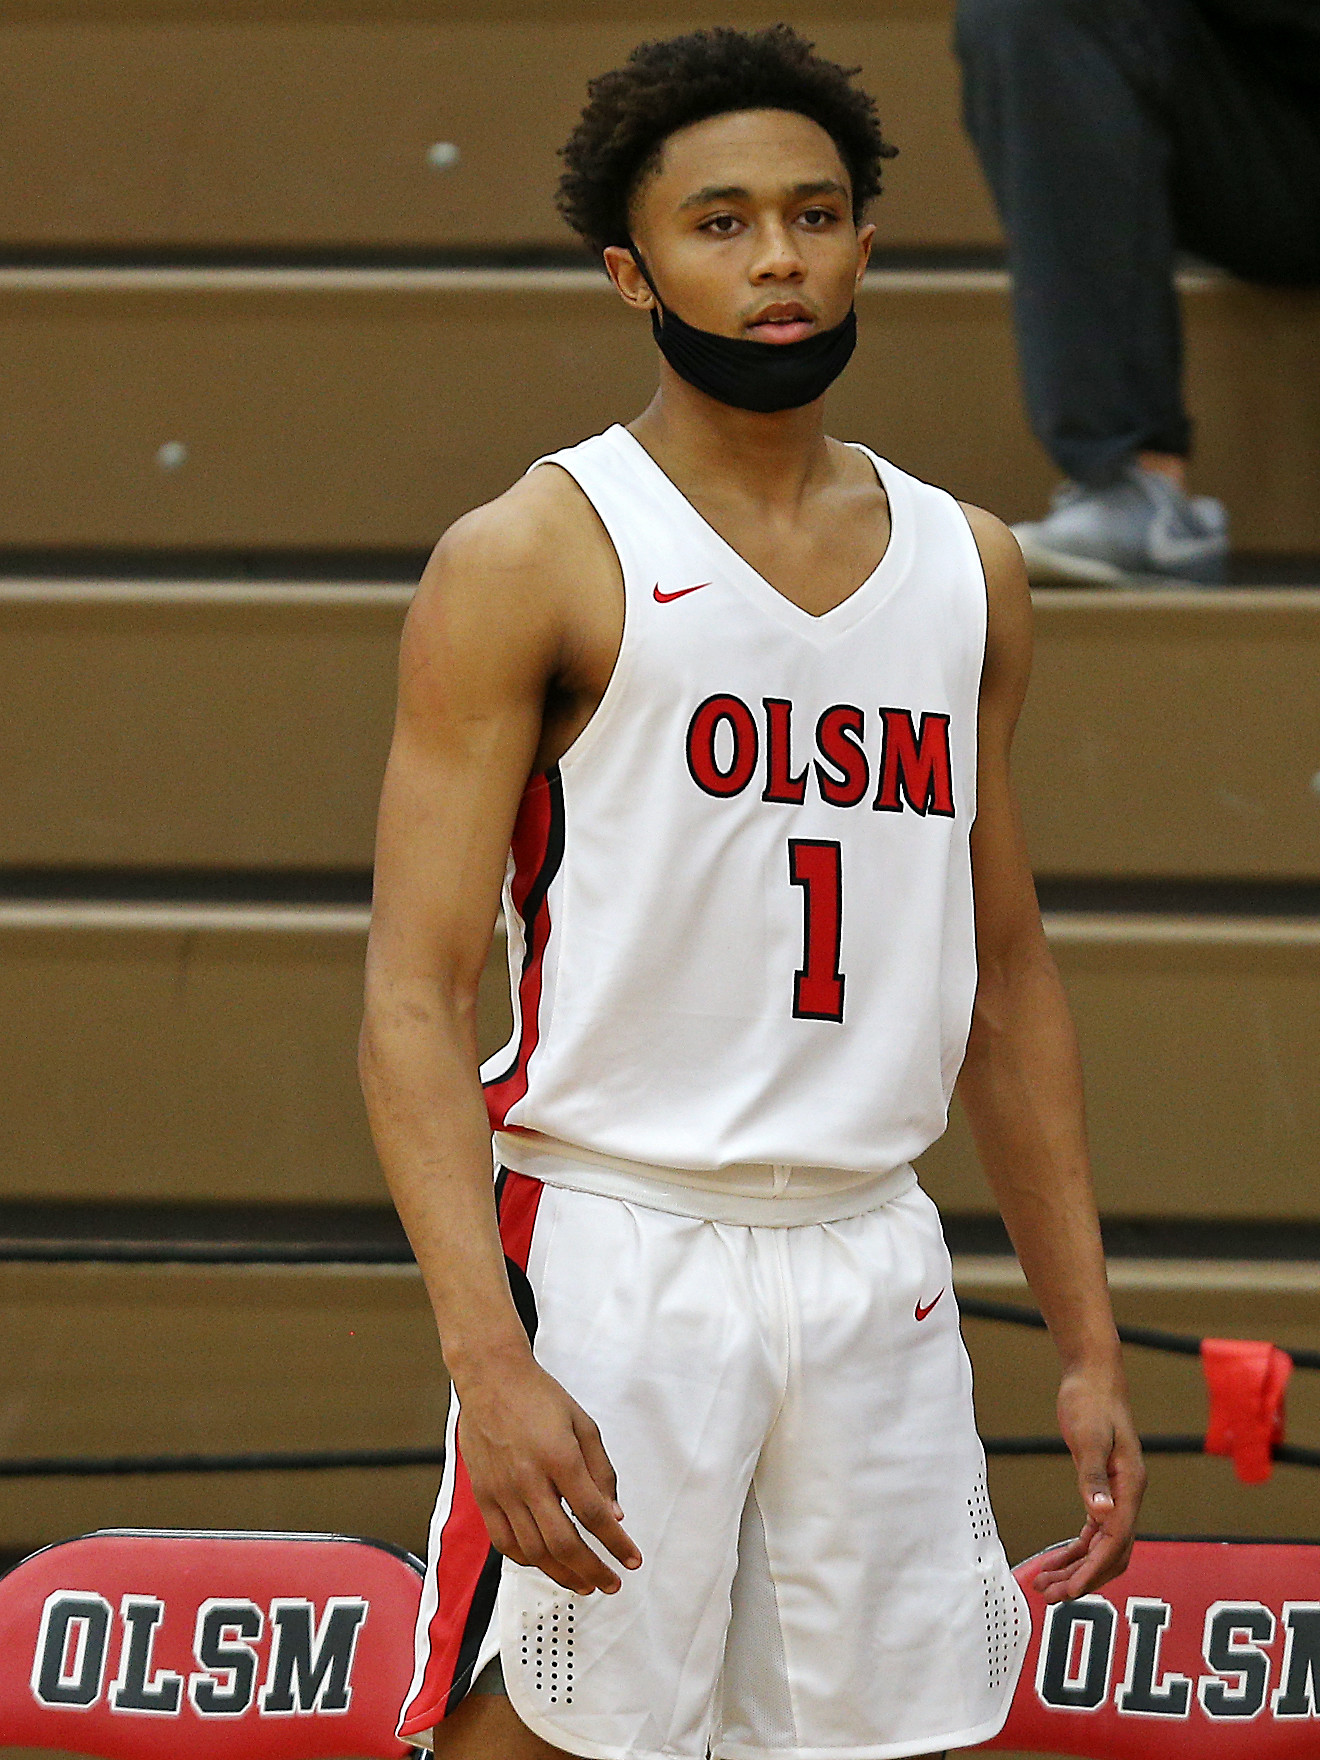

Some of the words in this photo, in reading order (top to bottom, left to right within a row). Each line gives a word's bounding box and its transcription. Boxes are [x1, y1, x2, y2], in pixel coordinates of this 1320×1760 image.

[685, 692, 956, 819] OLSM
[787, 837, 846, 1025] 1
[30, 1588, 369, 1717] OLSM
